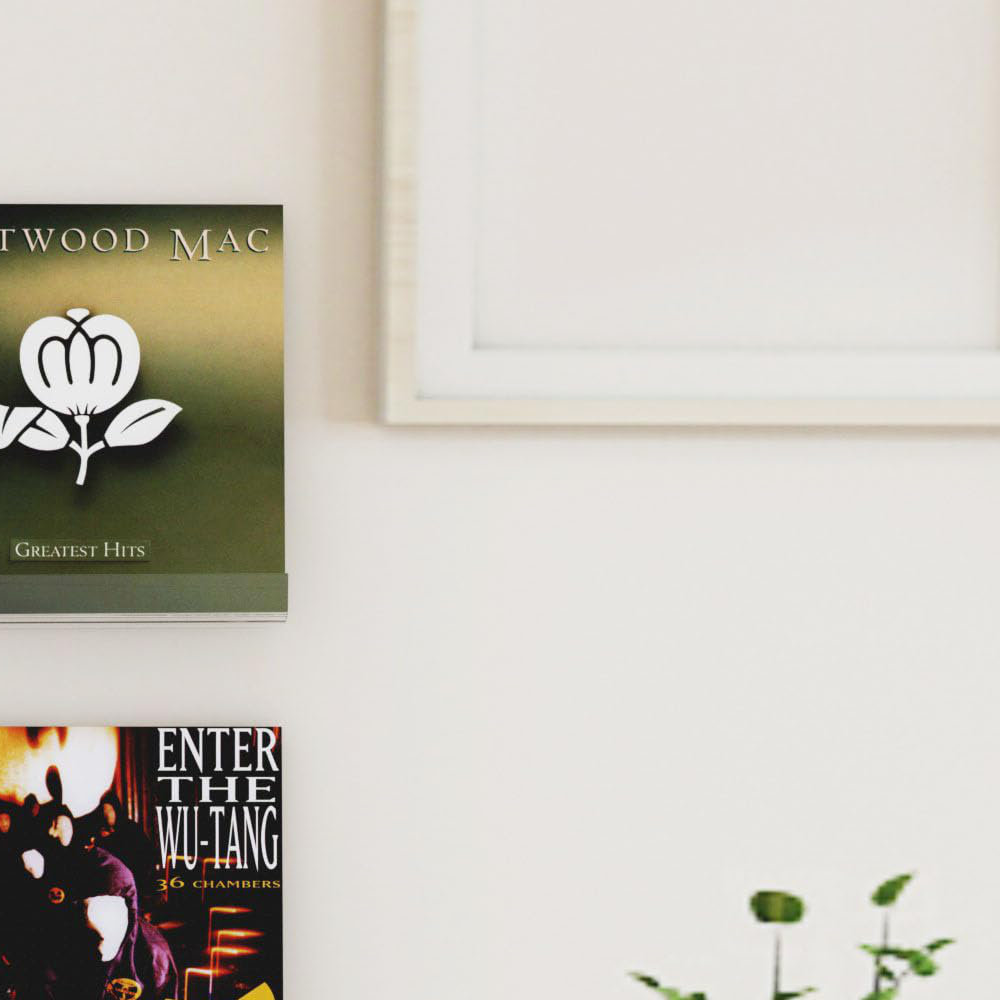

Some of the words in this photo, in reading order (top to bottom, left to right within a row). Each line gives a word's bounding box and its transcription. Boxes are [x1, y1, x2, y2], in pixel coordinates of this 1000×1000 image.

[157, 727, 280, 773] ENTER
[157, 776, 276, 803] THE
[156, 805, 279, 871] WU-TANG
[156, 876, 185, 891] 36
[192, 880, 281, 889] CHAMBERS
